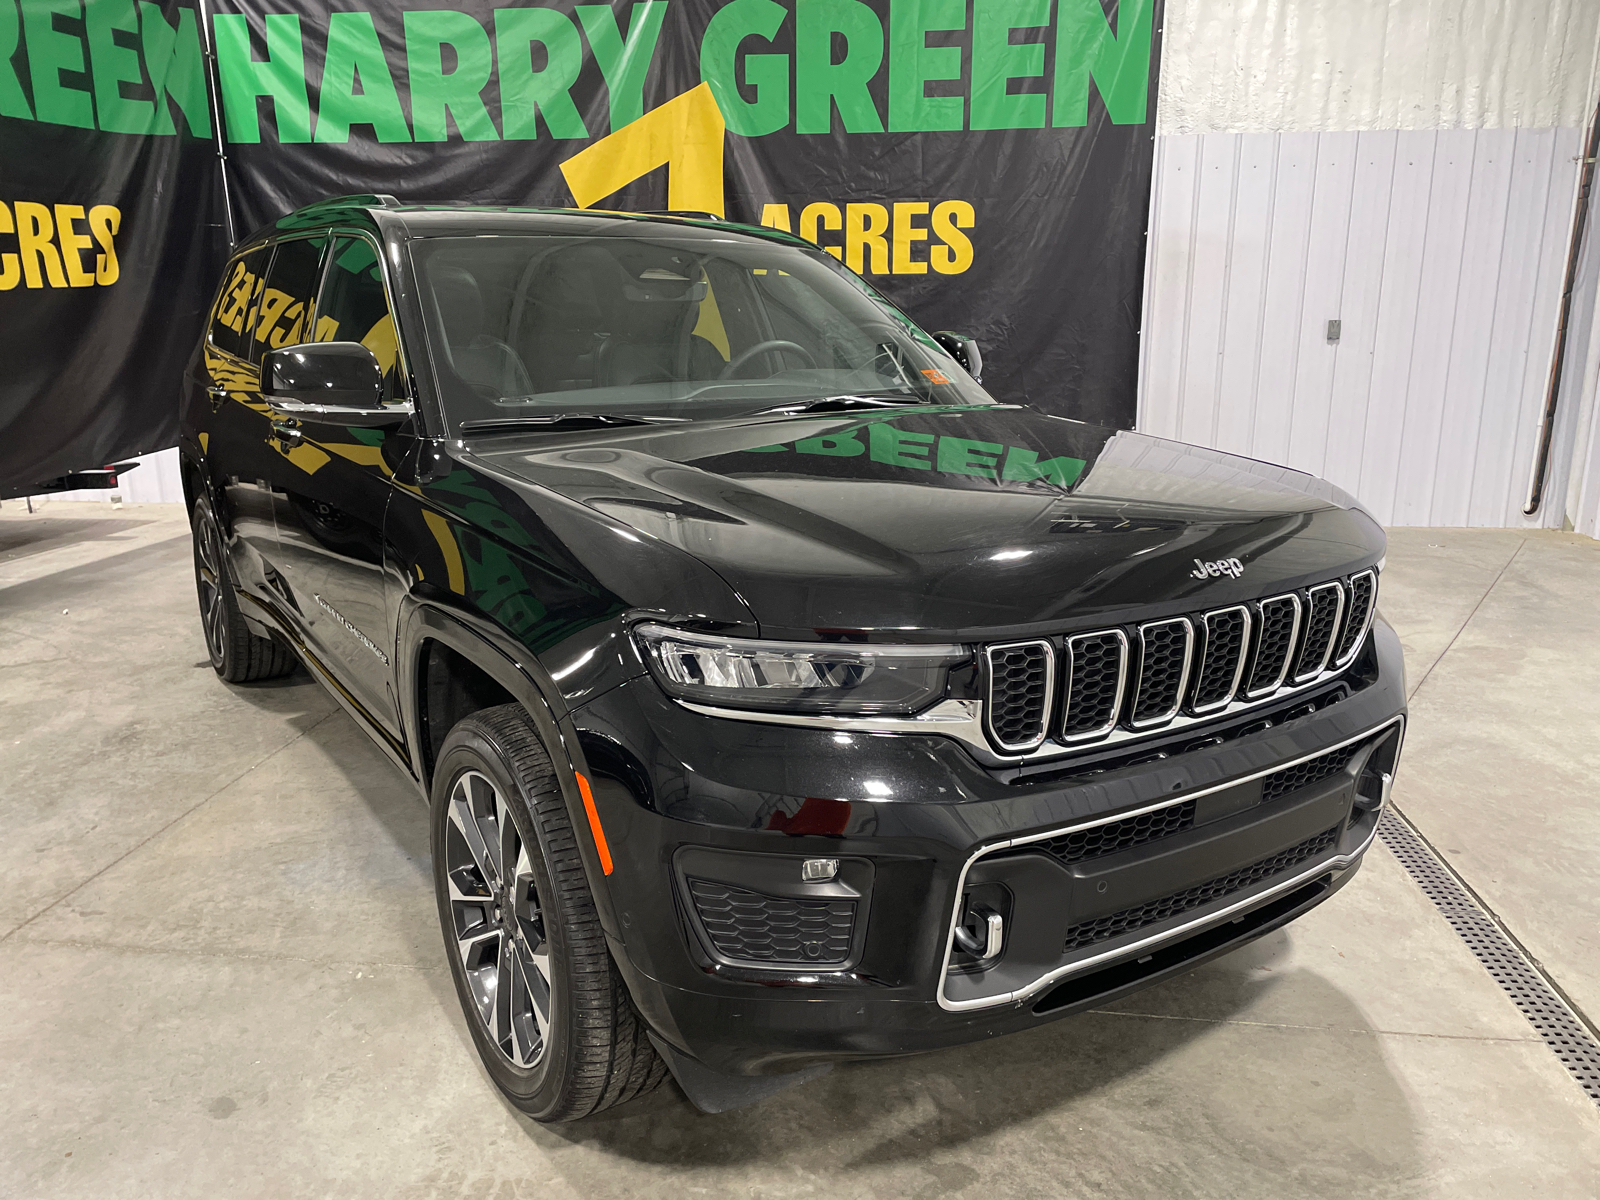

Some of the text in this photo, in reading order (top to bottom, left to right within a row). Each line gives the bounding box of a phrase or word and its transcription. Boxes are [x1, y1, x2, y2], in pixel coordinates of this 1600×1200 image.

[213, 0, 1152, 144] HARRY GREEN
[1191, 557, 1244, 579] Jeep
